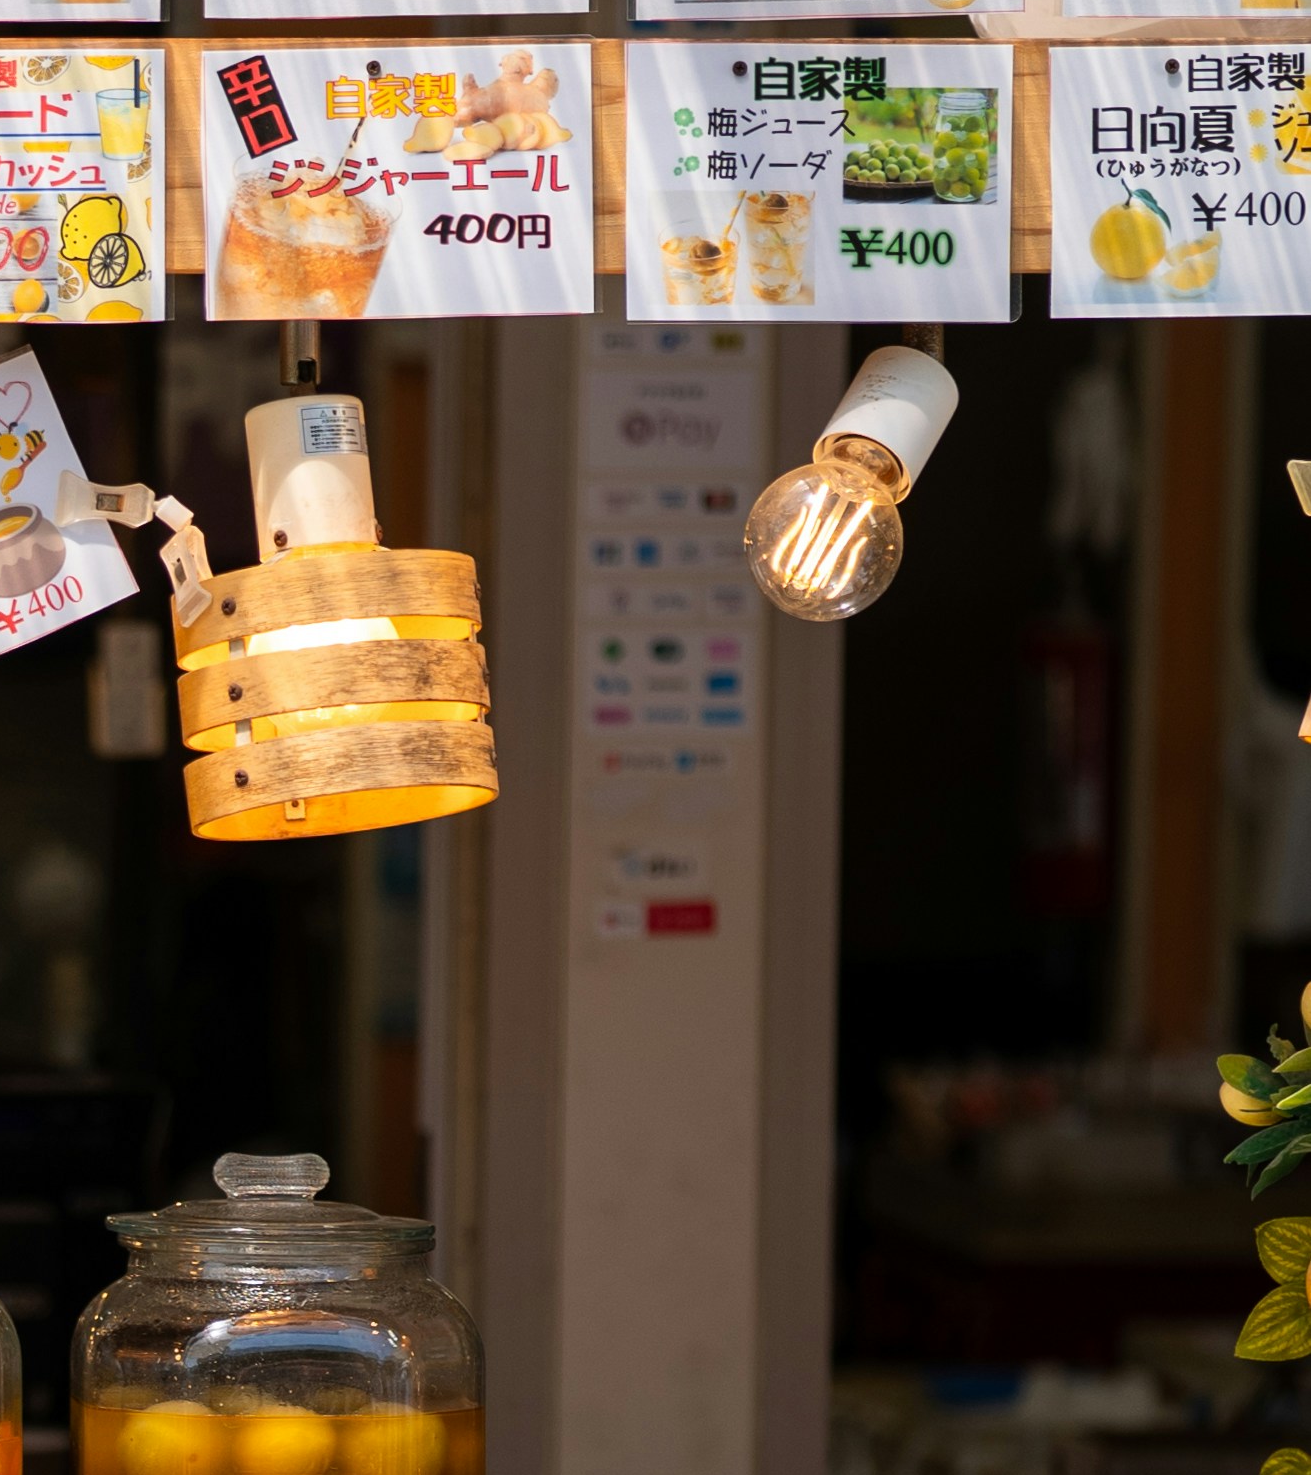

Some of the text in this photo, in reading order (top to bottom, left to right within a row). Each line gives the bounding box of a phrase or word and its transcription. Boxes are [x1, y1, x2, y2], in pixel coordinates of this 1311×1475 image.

[753, 56, 887, 101] 自家製
[1188, 53, 1305, 92] 自家製
[223, 59, 292, 156] 辛口
[326, 73, 457, 119] 自家製
[707, 107, 856, 138] 梅ジュース
[1092, 105, 1238, 154] 日向夏
[269, 155, 570, 198] ジンジャーエール
[707, 149, 832, 180] 梅ソーダ
[424, 213, 551, 249] 400円
[840, 229, 954, 268] ¥400
